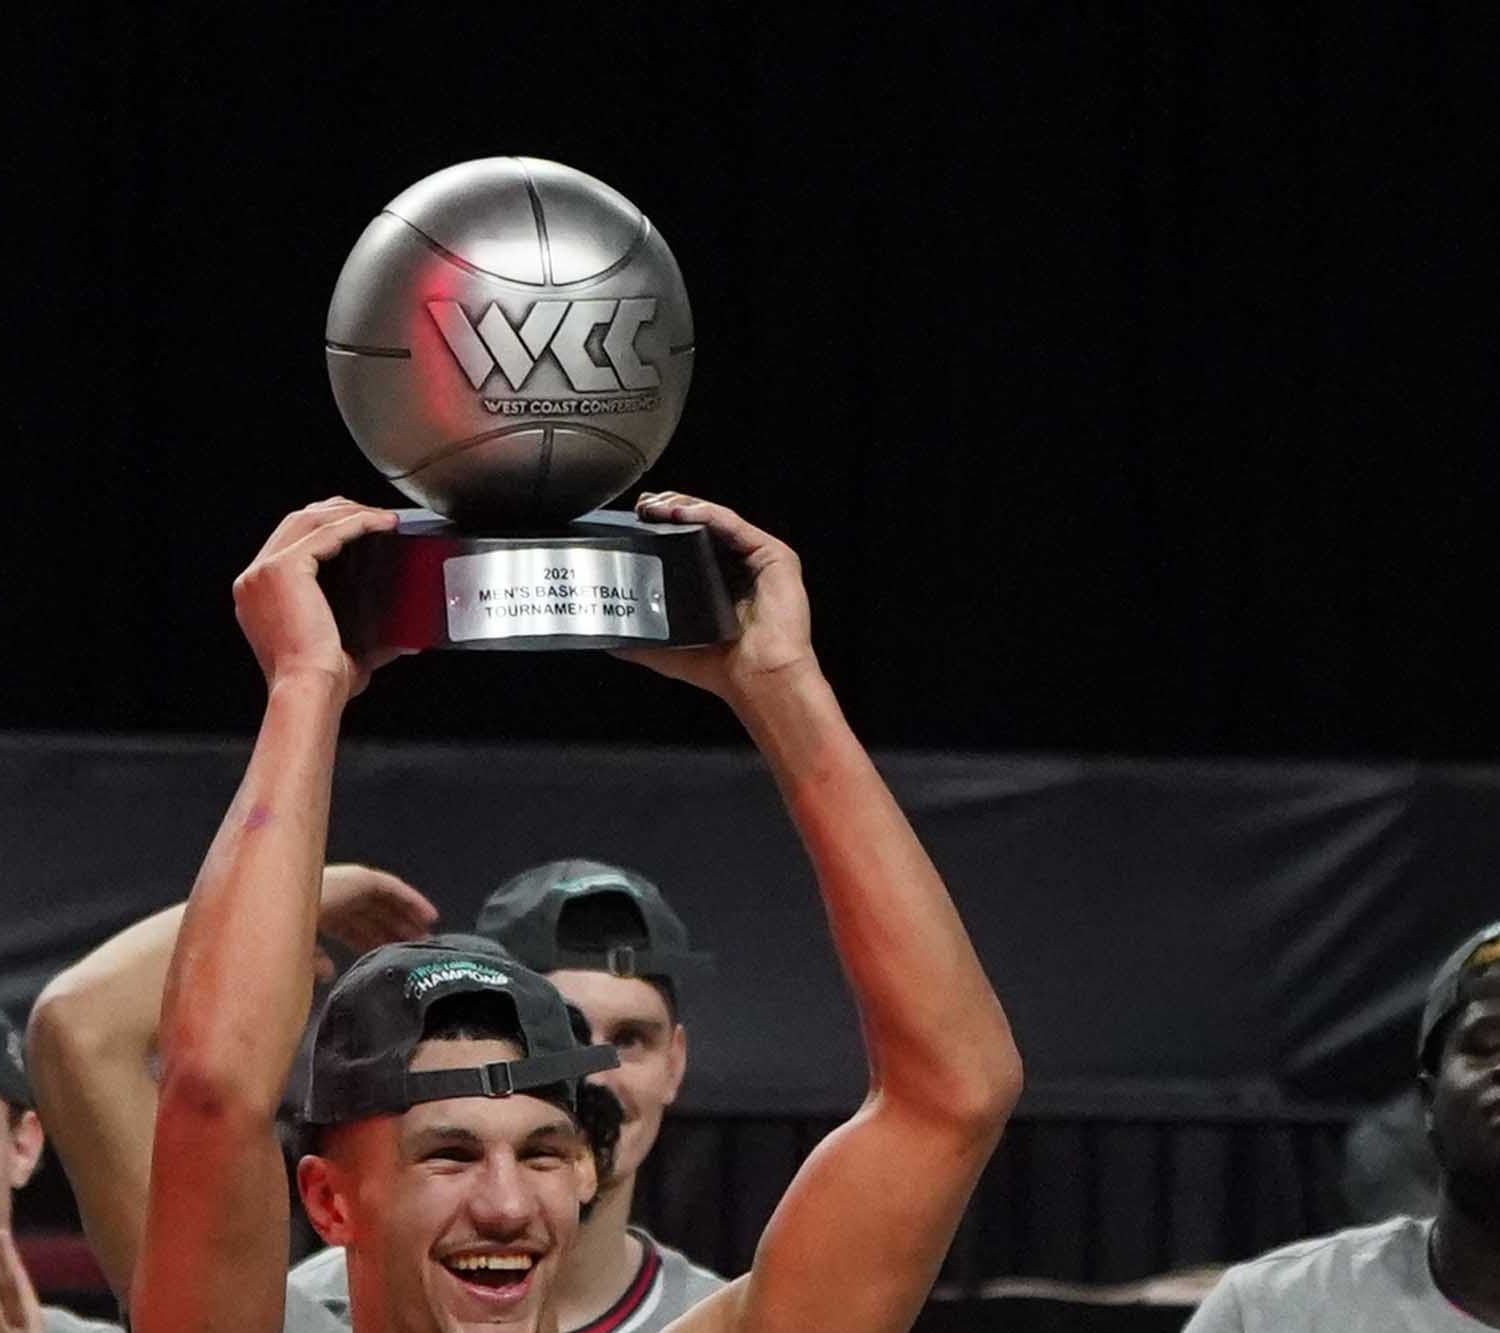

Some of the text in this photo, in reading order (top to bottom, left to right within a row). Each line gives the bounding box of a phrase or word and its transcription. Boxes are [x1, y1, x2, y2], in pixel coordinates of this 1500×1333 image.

[426, 299, 662, 394] WCC
[484, 400, 526, 415] WEST
[530, 400, 579, 415] COAST
[544, 567, 576, 580] 2021
[603, 603, 636, 618] MOP
